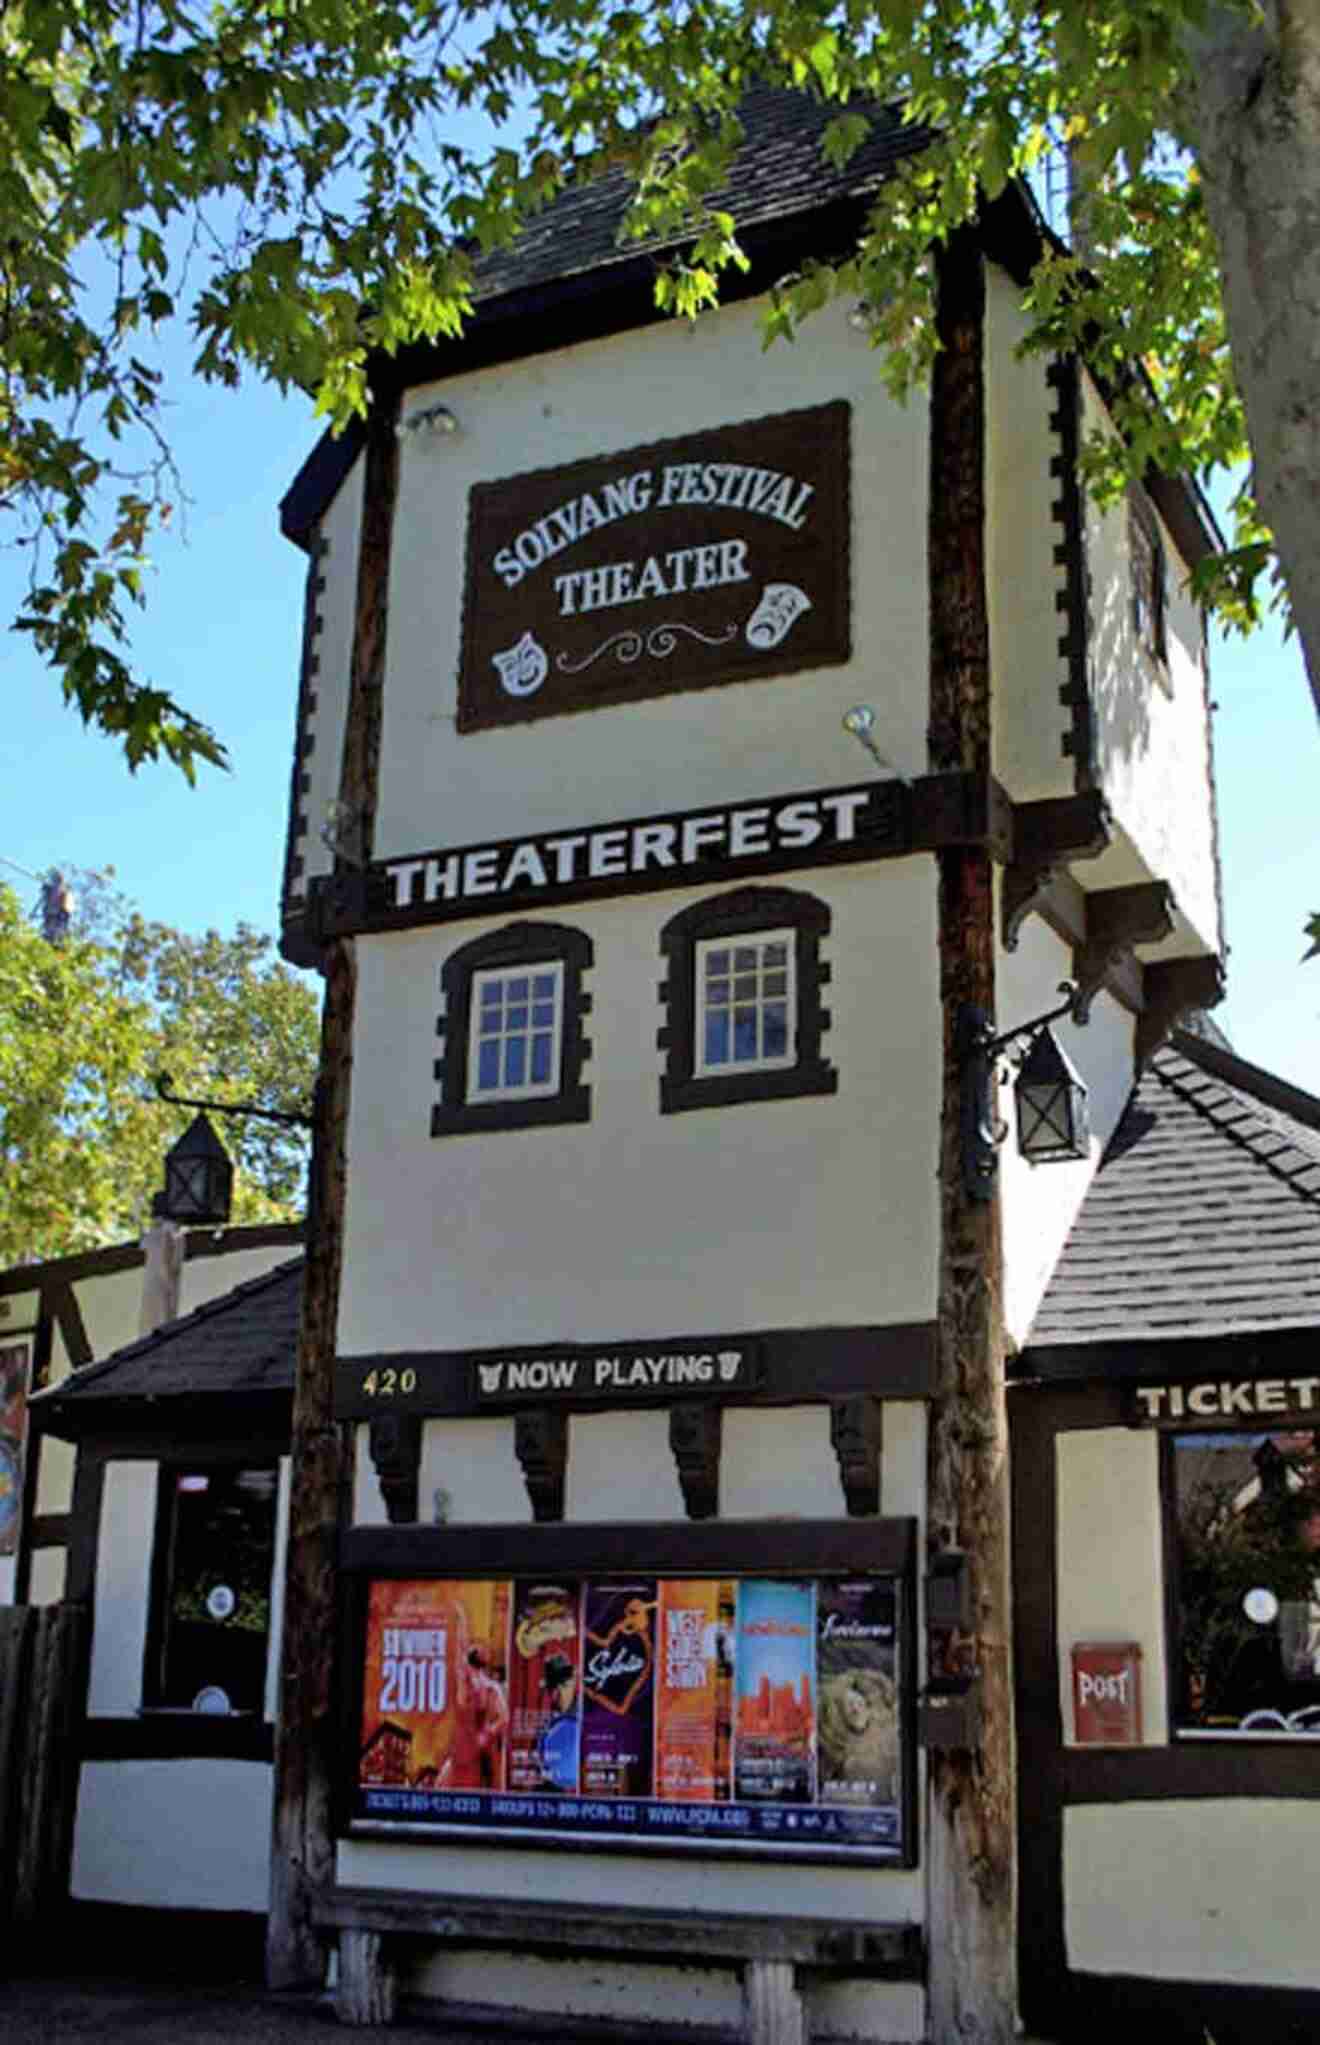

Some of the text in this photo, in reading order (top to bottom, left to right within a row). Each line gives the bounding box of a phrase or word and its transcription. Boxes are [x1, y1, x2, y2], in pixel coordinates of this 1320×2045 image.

[493, 462, 815, 587] SOLVANG FESTIVAL
[554, 538, 751, 616] THEATER
[386, 793, 870, 908] THEATERFEST
[363, 1368, 416, 1396] 420
[507, 1354, 714, 1390] NOW PLAYING
[1136, 1378, 1320, 1417] TICKET
[379, 1658, 448, 1712] 2010
